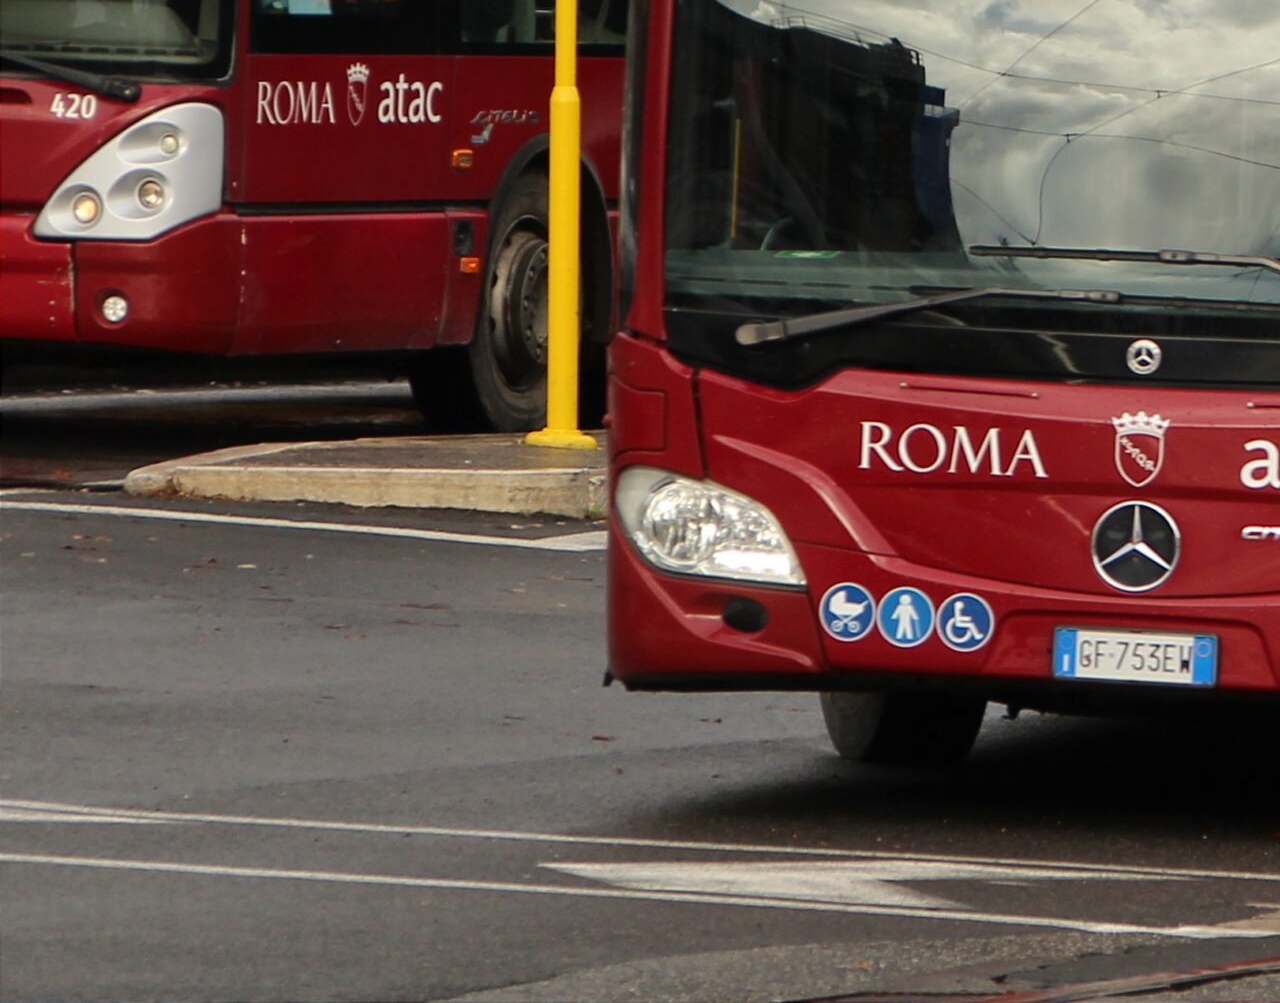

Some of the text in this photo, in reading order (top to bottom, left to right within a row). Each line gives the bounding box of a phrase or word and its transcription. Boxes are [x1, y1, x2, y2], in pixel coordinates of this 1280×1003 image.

[50, 93, 97, 119] 420
[256, 80, 336, 125] ROMA
[378, 73, 443, 124] atac
[857, 420, 1049, 478] ROMA
